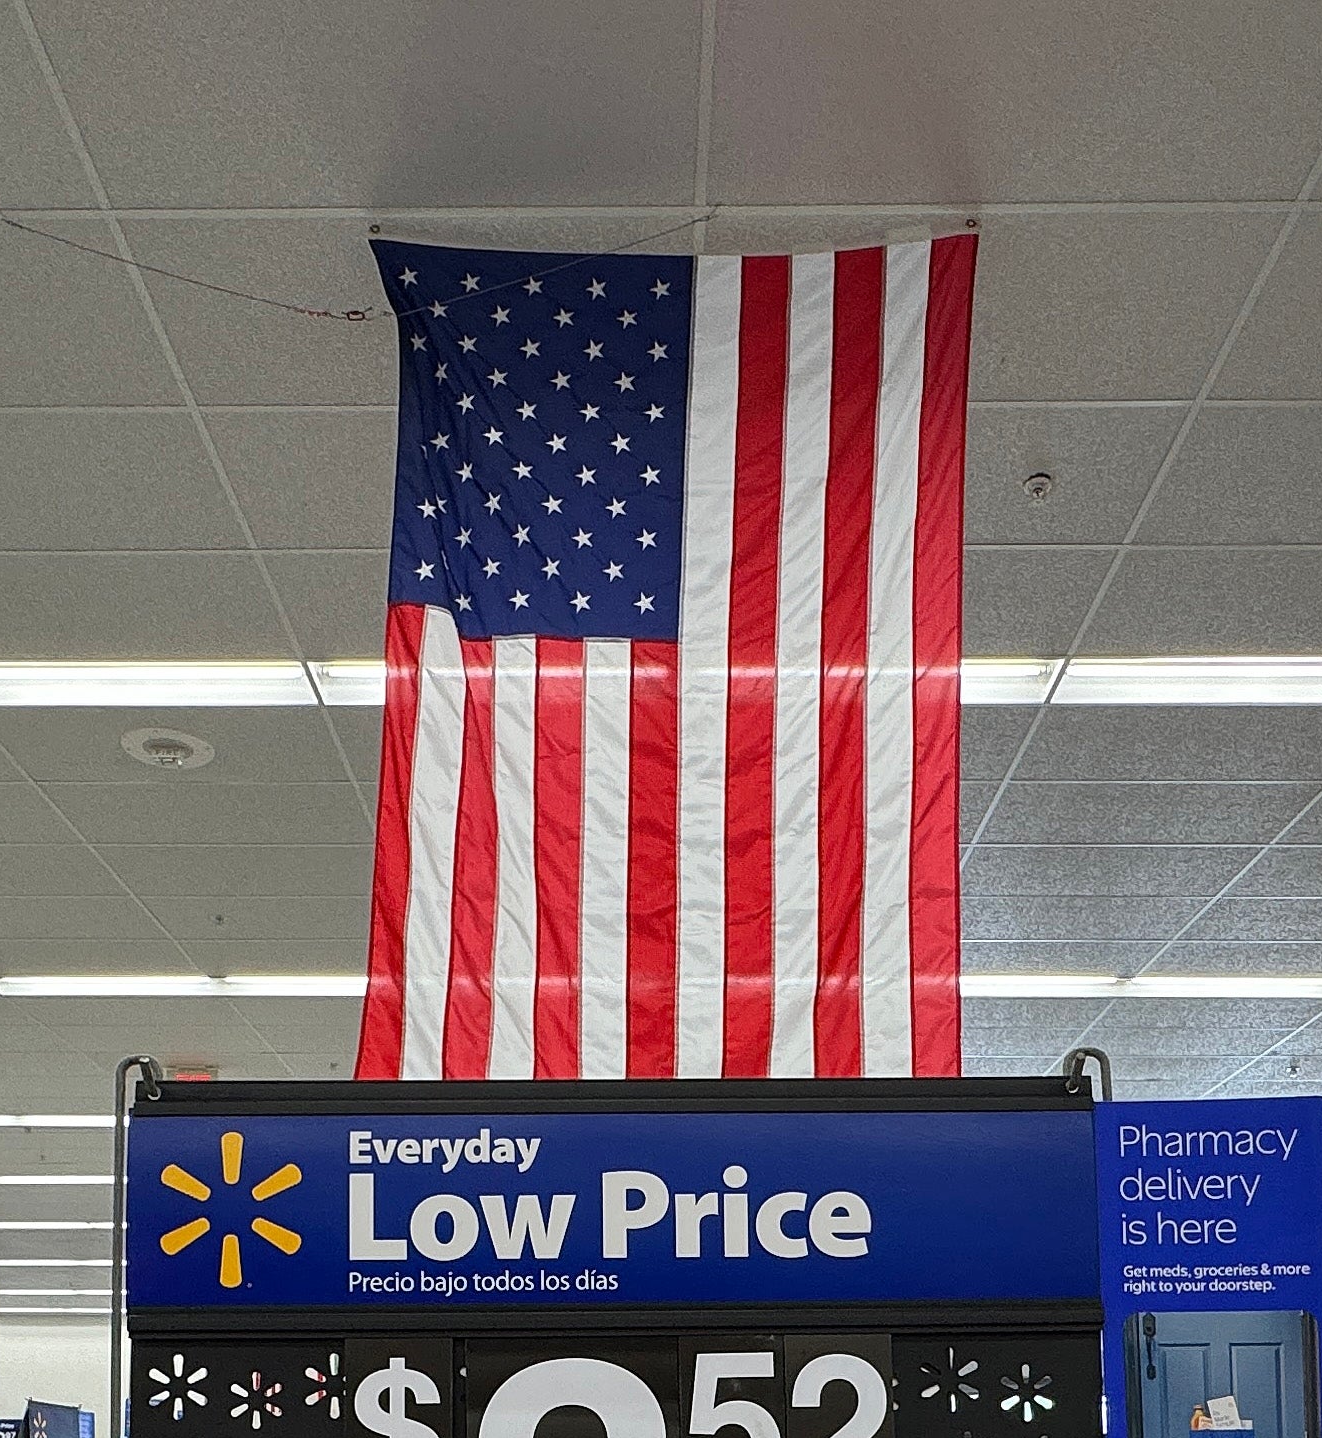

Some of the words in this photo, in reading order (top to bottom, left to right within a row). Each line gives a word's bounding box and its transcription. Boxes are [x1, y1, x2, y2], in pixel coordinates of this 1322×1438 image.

[348, 1129, 541, 1173] Everyday
[1119, 1124, 1298, 1161] Pharmacy
[1119, 1168, 1261, 1206] delivery
[348, 1172, 577, 1262] Low
[601, 1165, 872, 1259] Price
[1121, 1213, 1147, 1246] is
[1158, 1212, 1237, 1246] here
[348, 1270, 414, 1293] Precio
[419, 1270, 468, 1297] bajo
[472, 1269, 535, 1292] todos
[539, 1269, 570, 1291] los
[573, 1268, 619, 1292] días
[1123, 1264, 1147, 1278] Get
[1150, 1264, 1192, 1279] meds,
[1194, 1263, 1258, 1279] groceries
[1261, 1262, 1270, 1276] &
[1273, 1264, 1311, 1275] more
[1123, 1279, 1156, 1294] right
[1159, 1281, 1173, 1292] to
[1175, 1281, 1206, 1294] your
[1208, 1279, 1276, 1294] doorstep.
